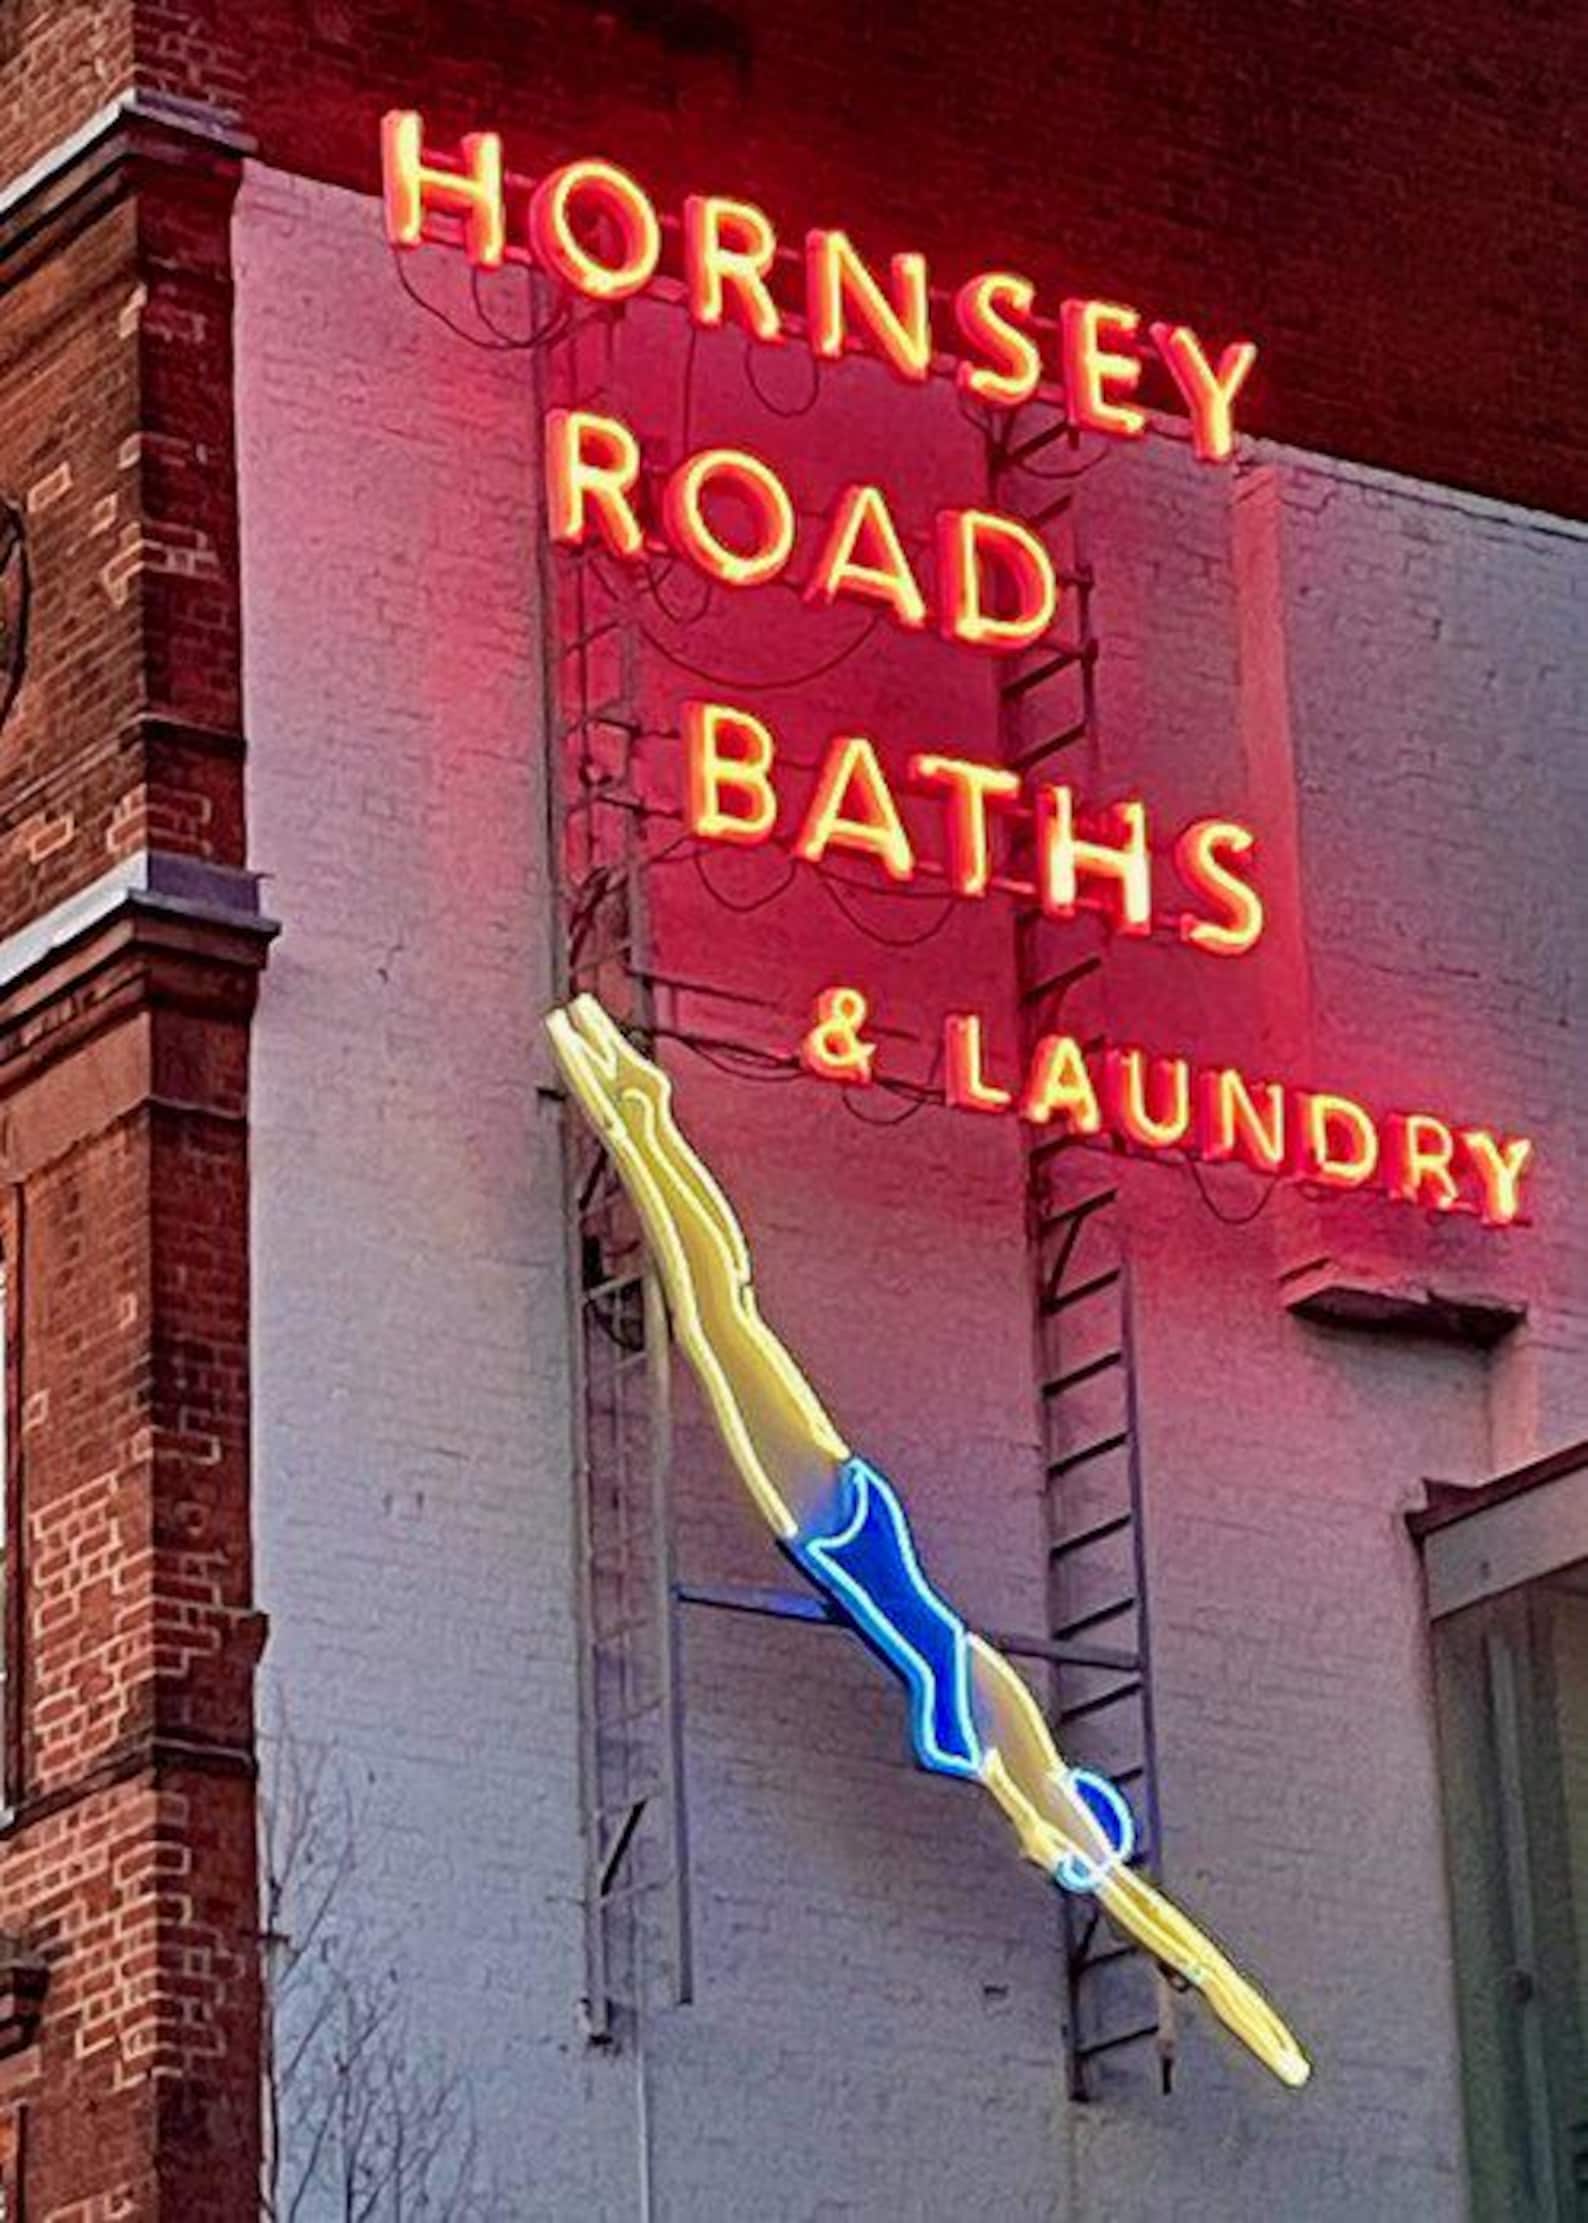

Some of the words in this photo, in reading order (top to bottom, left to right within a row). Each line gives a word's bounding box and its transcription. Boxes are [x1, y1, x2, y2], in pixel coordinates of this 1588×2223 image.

[381, 109, 1258, 461] HORNSEY
[545, 409, 1059, 649] ROAD
[685, 702, 1265, 956] BATHS
[802, 988, 874, 1082] &
[945, 1013, 1532, 1225] LAUNDRY
